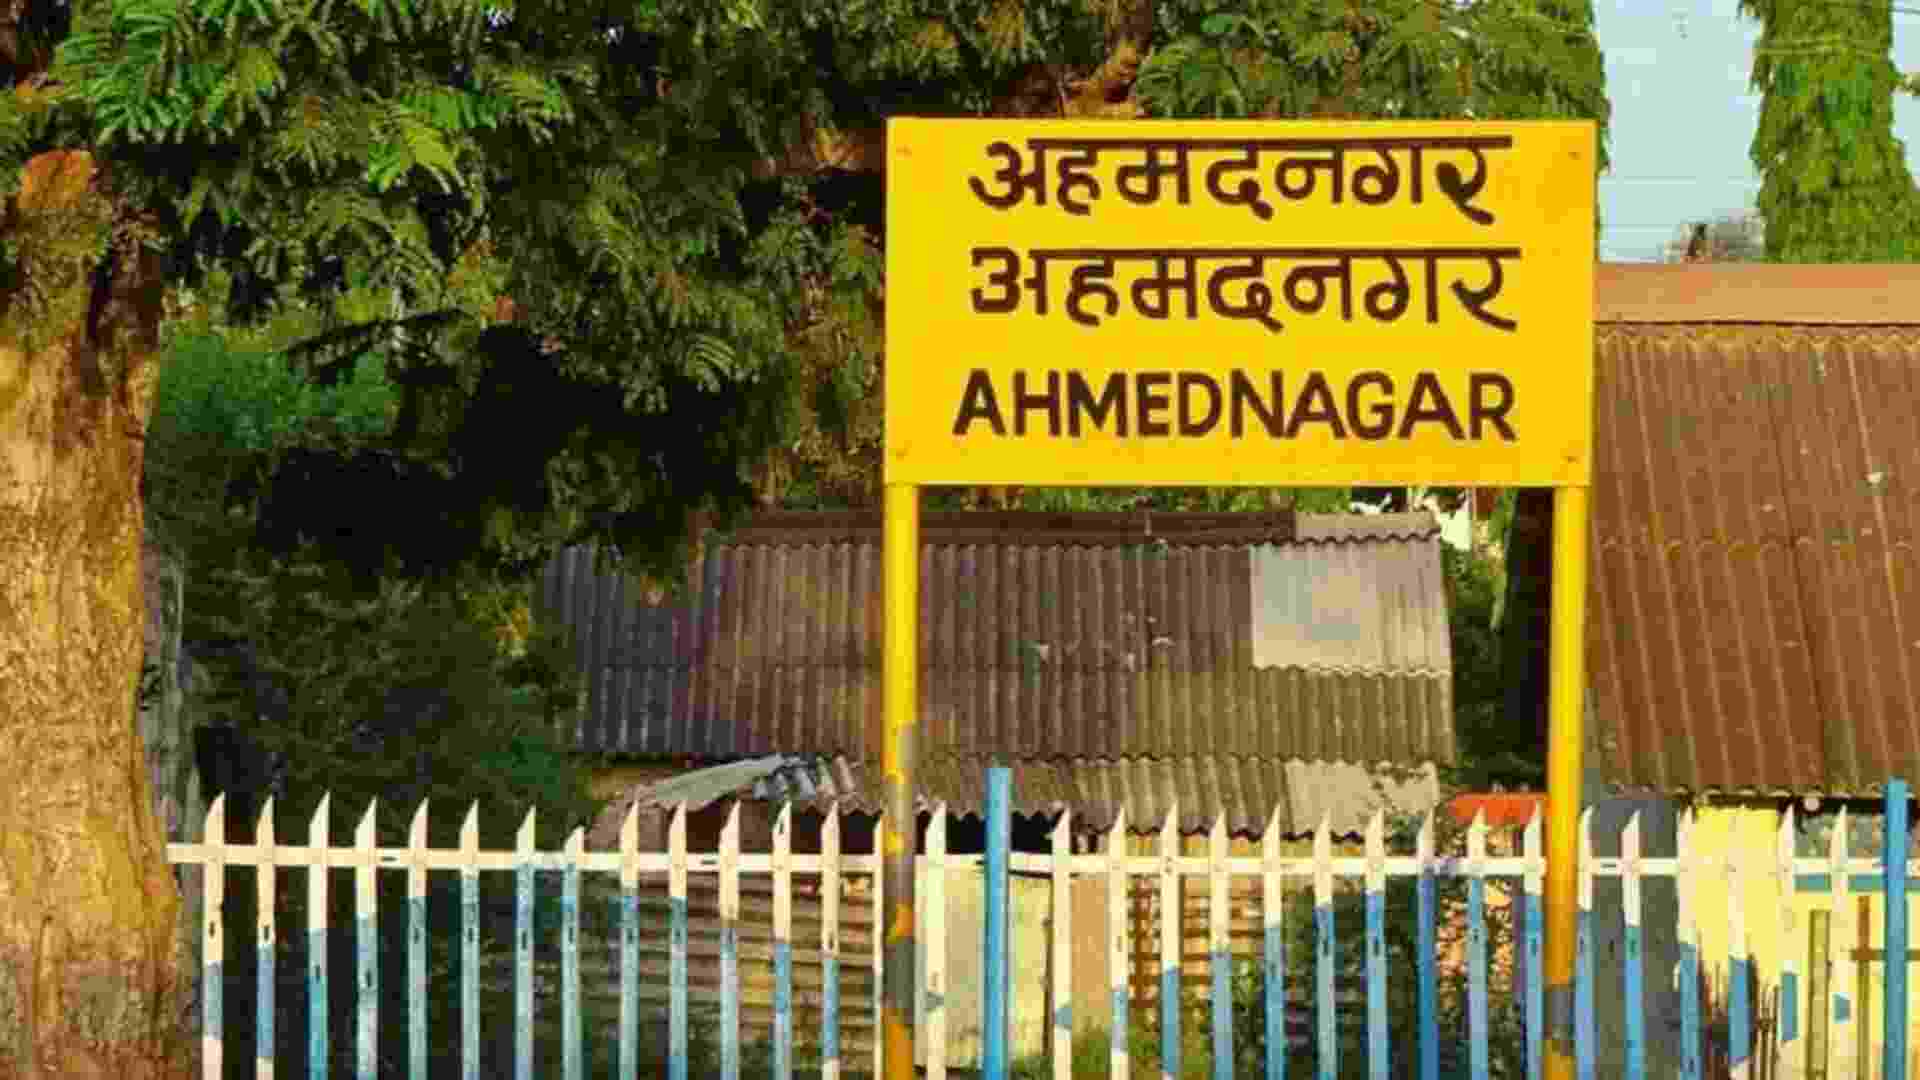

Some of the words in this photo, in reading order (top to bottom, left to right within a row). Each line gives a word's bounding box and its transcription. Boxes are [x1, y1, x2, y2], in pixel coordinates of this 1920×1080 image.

[968, 136, 1513, 225] अहमदनगर
[970, 246, 1521, 333] अहमदनगर
[952, 368, 1517, 442] AHMEDNAGAR
